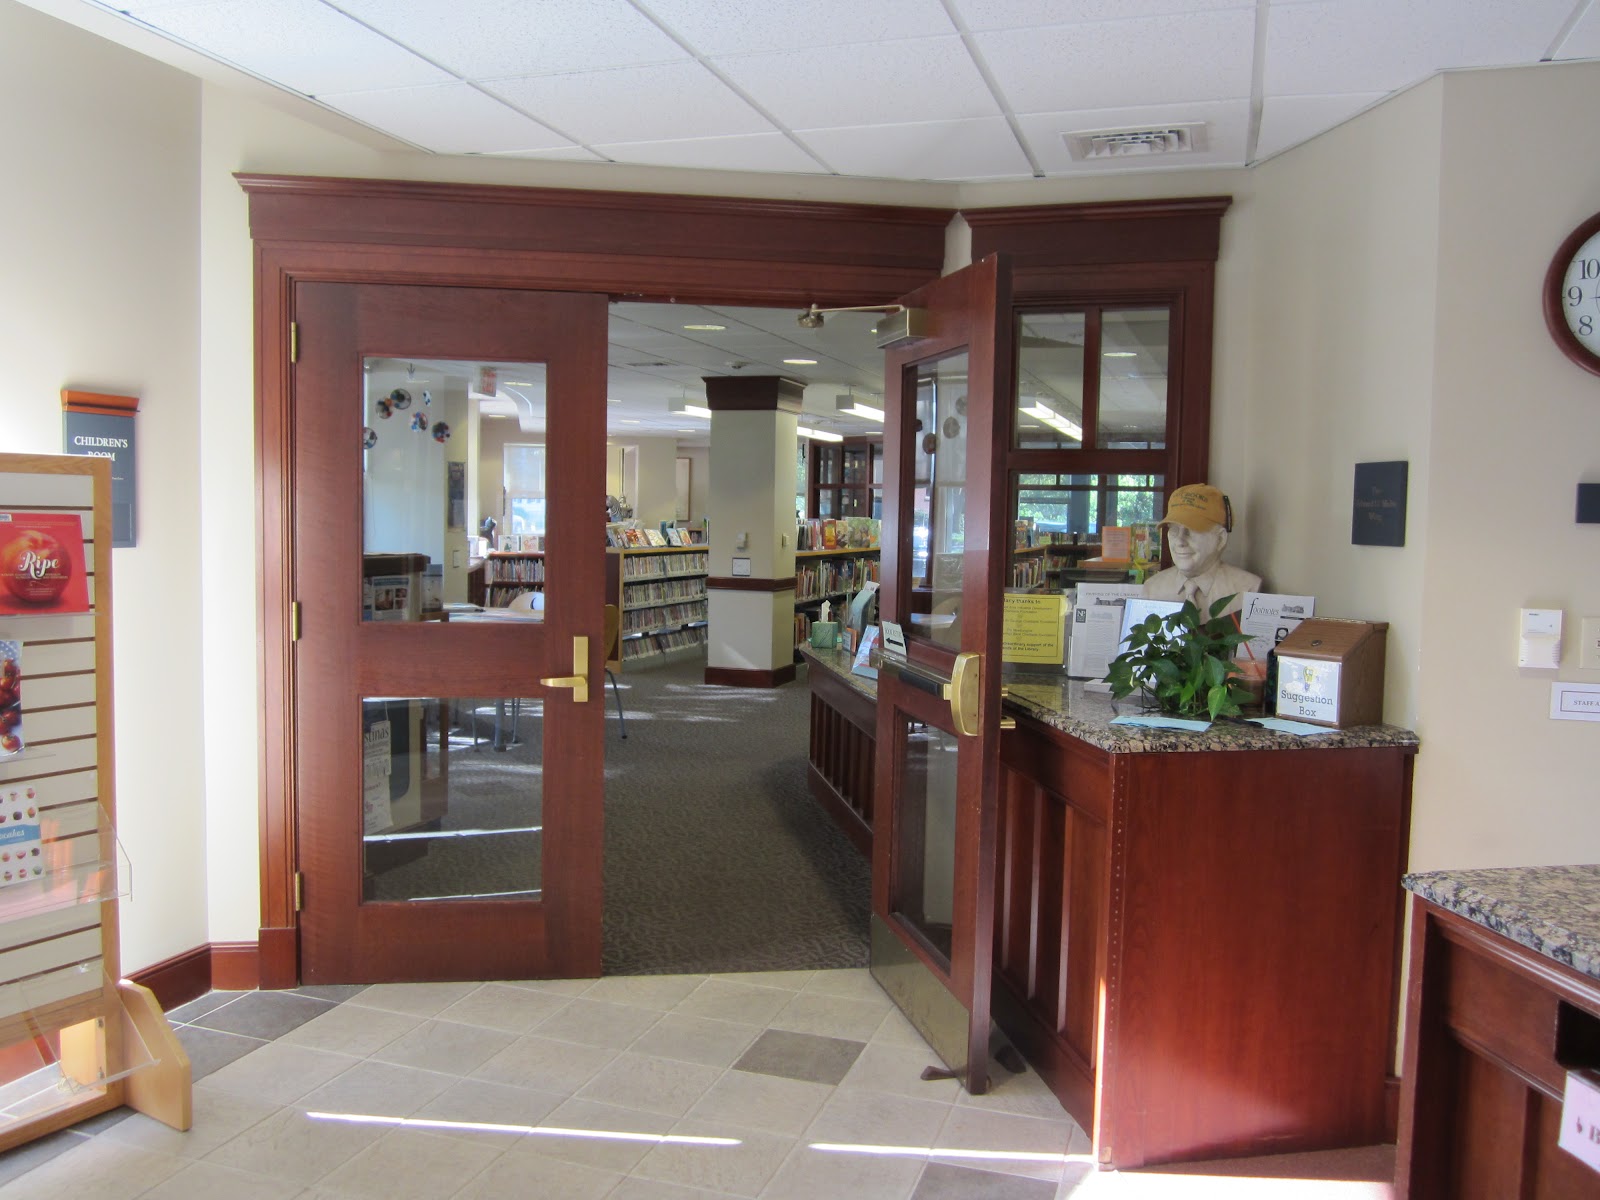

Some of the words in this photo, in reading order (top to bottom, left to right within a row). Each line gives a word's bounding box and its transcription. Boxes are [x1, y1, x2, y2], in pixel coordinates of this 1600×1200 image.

[1578, 258, 1600, 280] 10
[1567, 285, 1583, 307] 9
[1578, 314, 1593, 336] 8
[74, 435, 128, 448] CHILDREN'S
[18, 550, 60, 580] Ripe
[1246, 597, 1279, 620] footnotes
[1281, 689, 1333, 706] Suggestion
[1298, 705, 1317, 717] Box
